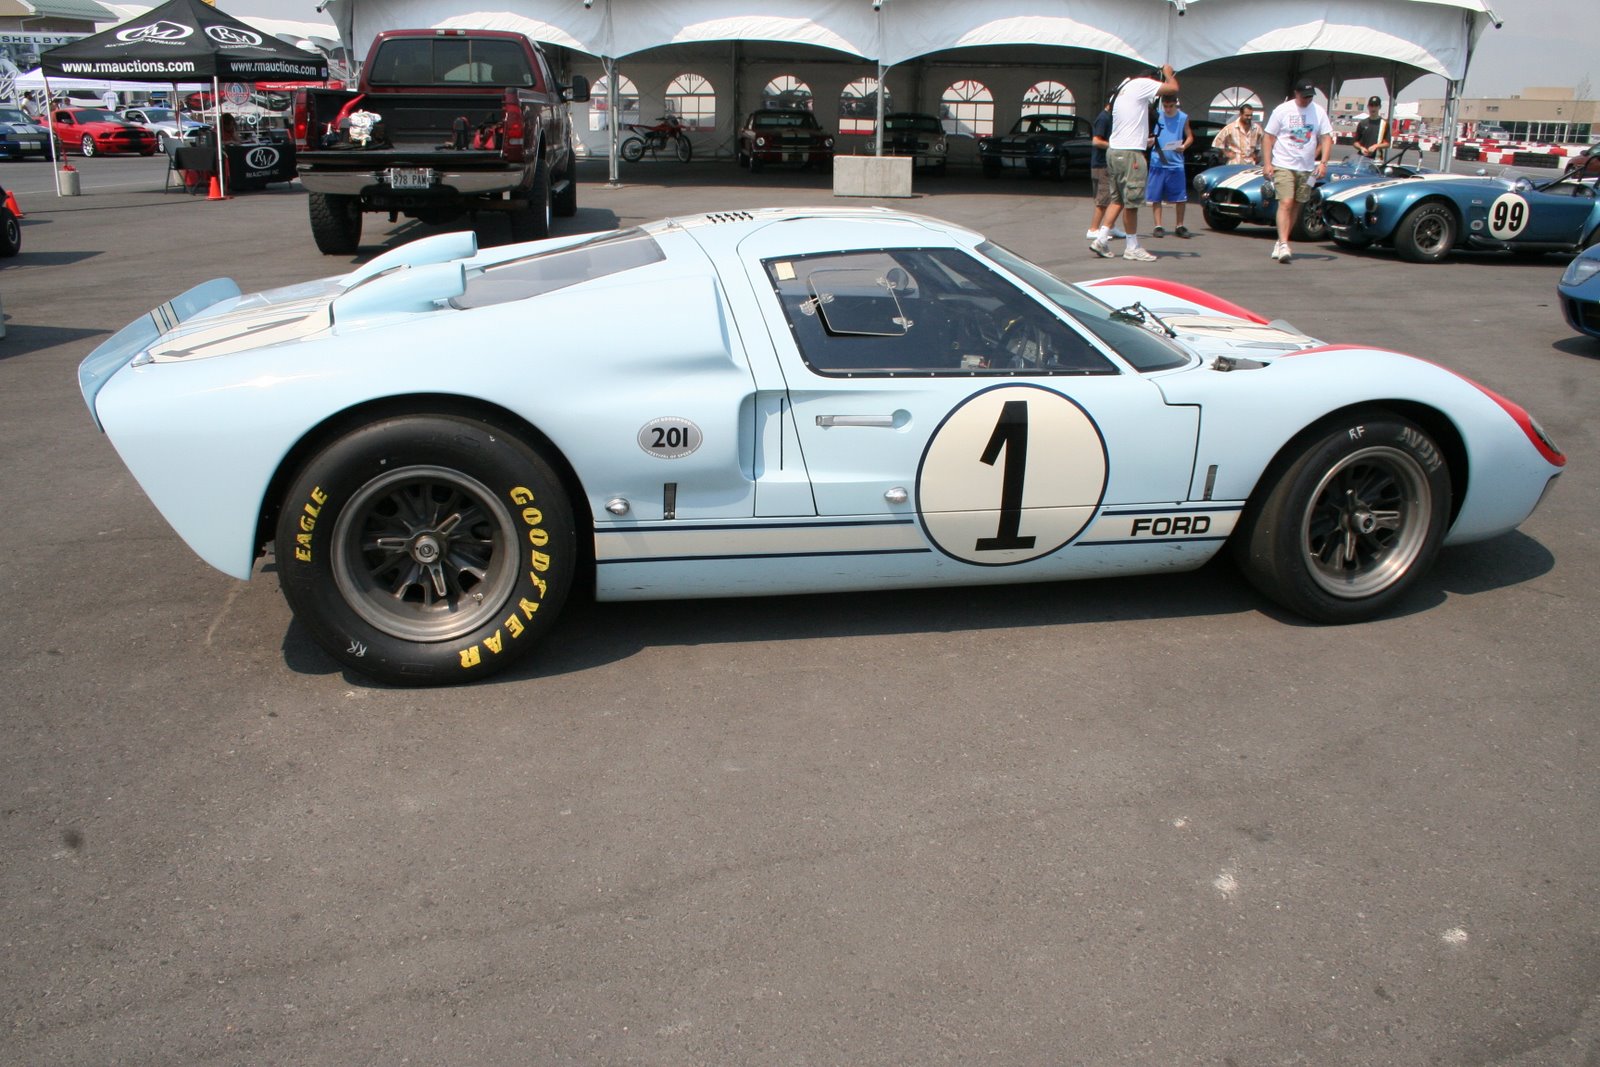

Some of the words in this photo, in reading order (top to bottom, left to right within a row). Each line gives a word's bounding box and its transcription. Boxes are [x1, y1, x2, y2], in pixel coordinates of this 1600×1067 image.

[1, 35, 63, 44] SHELBY
[213, 27, 250, 44] RM
[62, 60, 195, 73] www.rmauctions.com
[230, 61, 317, 76] www.rmauctions.com
[393, 174, 408, 185] 978
[1492, 201, 1524, 232] 99
[1348, 426, 1365, 440] RF
[1398, 426, 1442, 473] AVON
[975, 400, 1037, 551] 1
[295, 486, 328, 562] EAGLE
[1130, 516, 1211, 537] FORD
[459, 486, 551, 669] GOODYEAR
